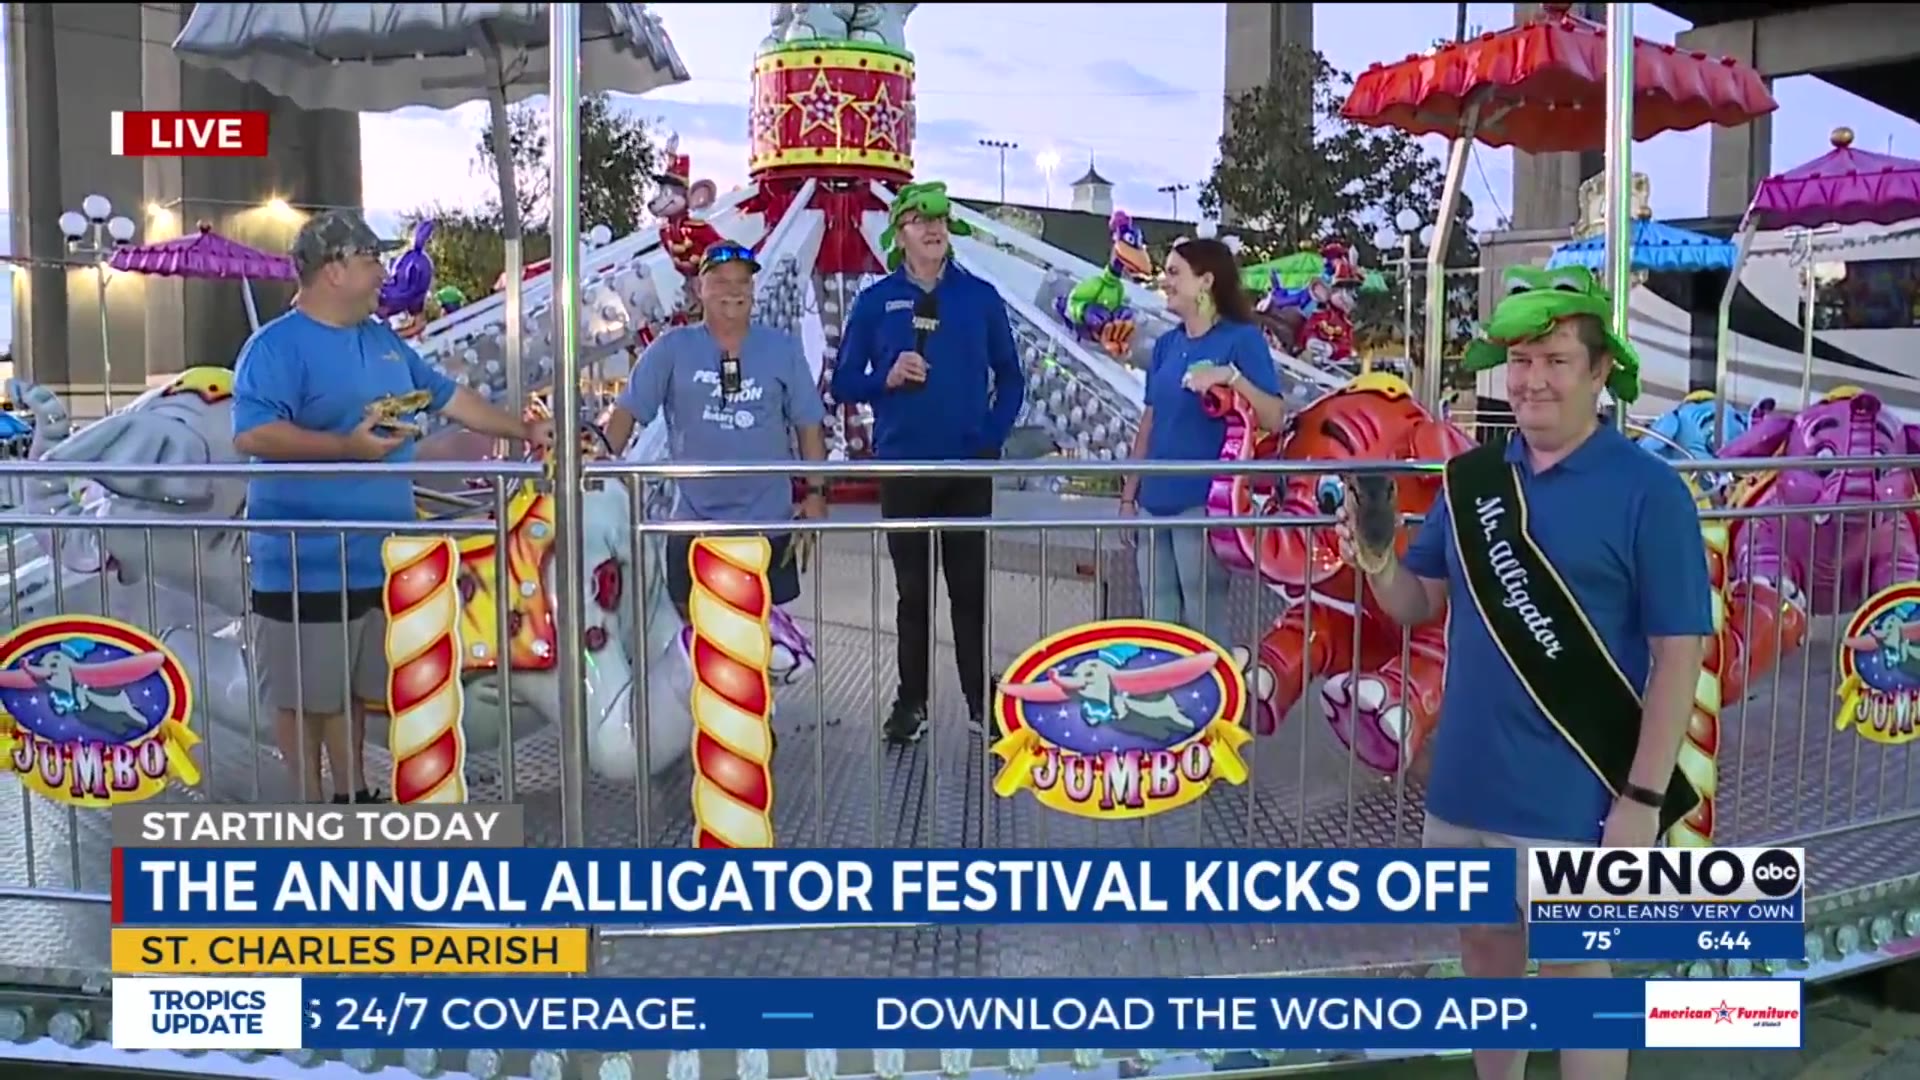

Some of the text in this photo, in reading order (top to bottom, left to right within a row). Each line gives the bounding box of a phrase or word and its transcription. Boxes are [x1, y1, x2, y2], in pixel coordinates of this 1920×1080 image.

[1488, 540, 1564, 660] Alligator
[13, 733, 168, 799] JUMBO
[1032, 741, 1212, 810] JUMBO
